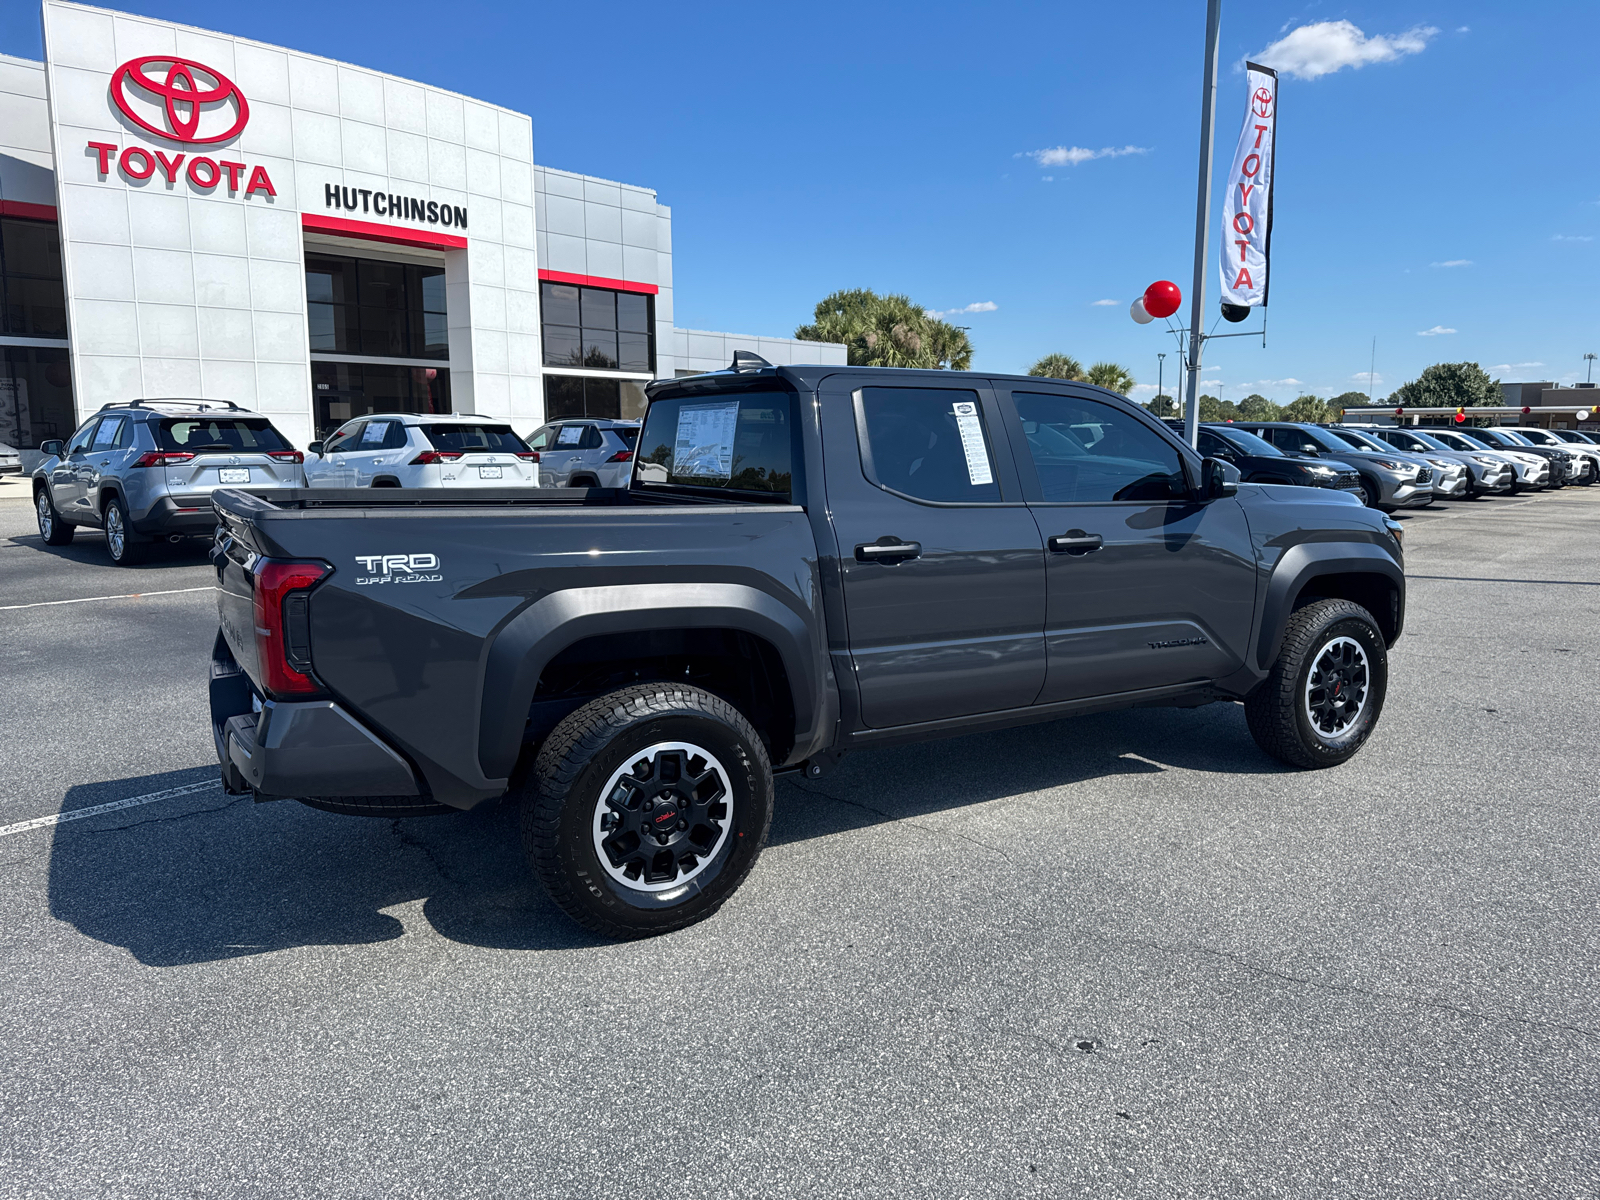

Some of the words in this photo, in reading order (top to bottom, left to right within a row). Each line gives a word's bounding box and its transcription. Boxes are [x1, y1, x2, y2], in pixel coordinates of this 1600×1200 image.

[88, 141, 277, 196] TOYOTA
[325, 183, 468, 228] HUTCHINSON
[1233, 124, 1267, 289] TOYOTA
[355, 553, 440, 576] TRD
[355, 576, 391, 585] OFF
[394, 575, 443, 584] ROAD
[1147, 637, 1207, 649] TACOMA
